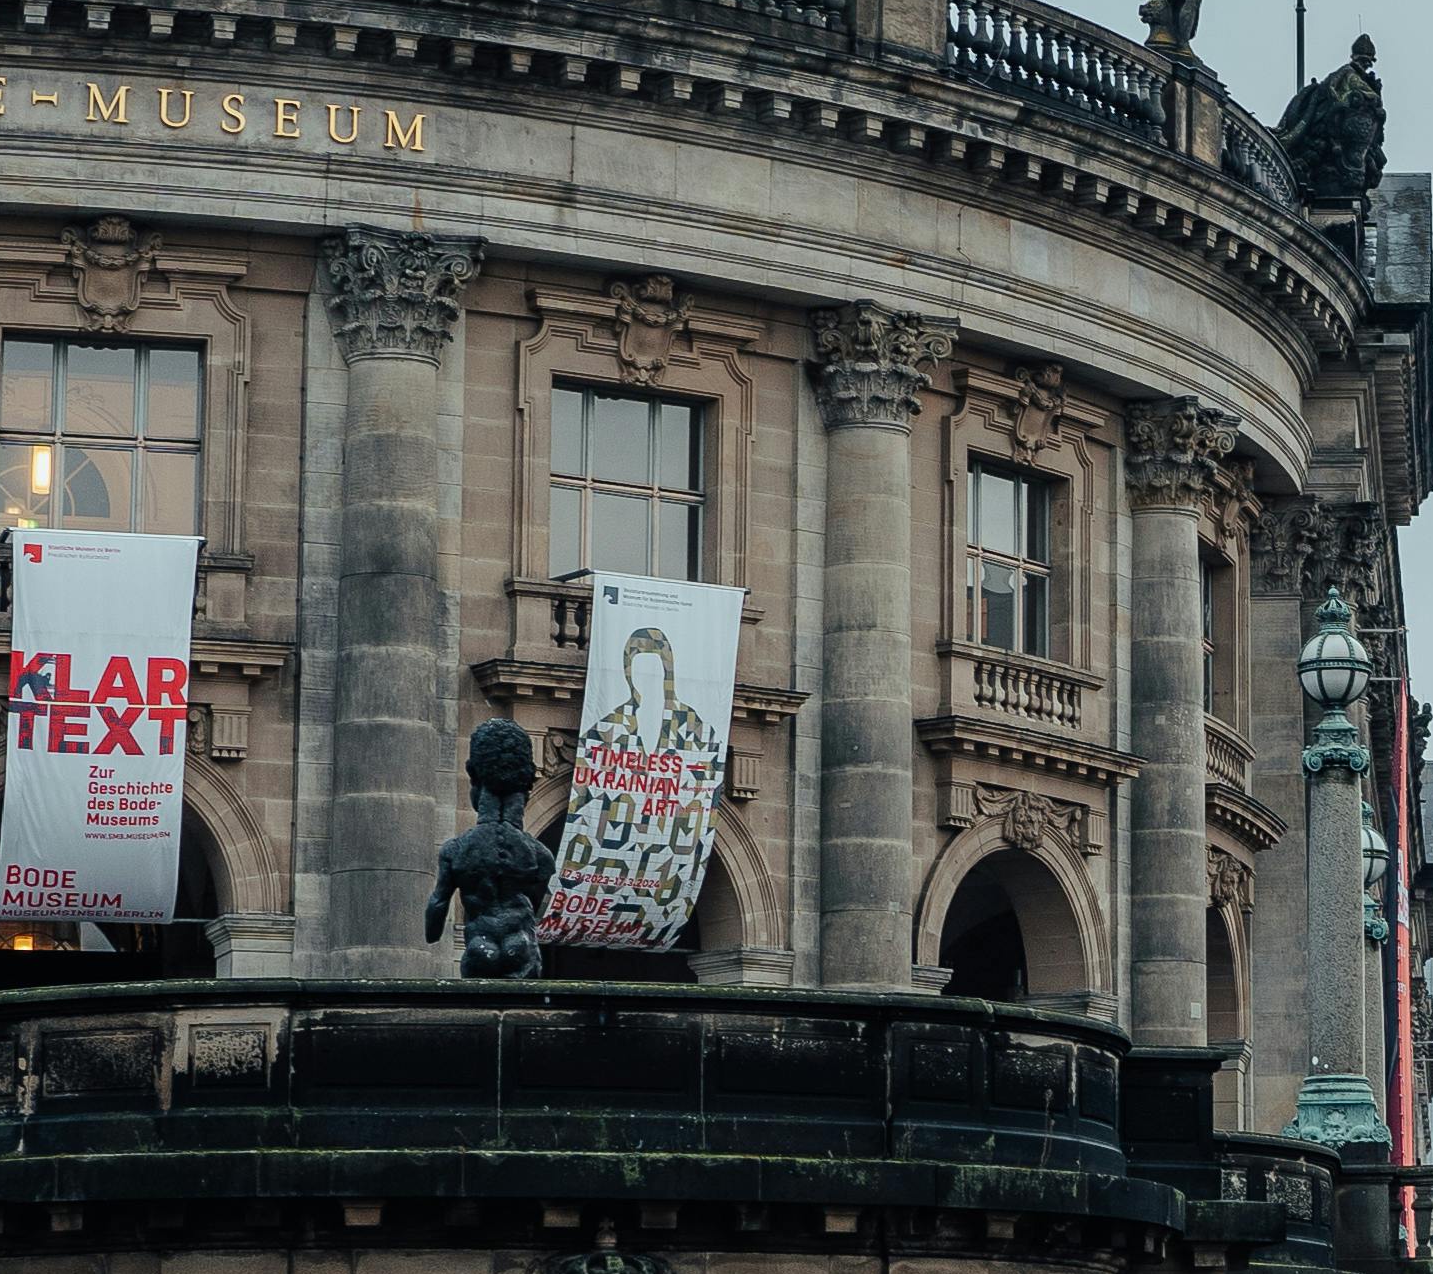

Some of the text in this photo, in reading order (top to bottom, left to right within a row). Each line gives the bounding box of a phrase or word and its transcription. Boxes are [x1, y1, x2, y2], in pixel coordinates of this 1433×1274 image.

[9, 651, 187, 705] KLAR
[8, 701, 187, 755] TEXT
[590, 746, 683, 774] TIMELESS
[89, 765, 115, 779] Zur
[575, 766, 680, 796] UKRAINIAN
[88, 781, 173, 795] Geschichte
[87, 797, 162, 811] des Bode-
[641, 798, 680, 817] ART
[87, 812, 159, 826] Museums
[5, 864, 77, 889] BODE
[2, 889, 122, 908] MUSEUM
[551, 891, 614, 916] BODE
[1, 908, 164, 918] MUSEUMSINSEL BERLIN
[537, 914, 644, 936] MUSEUM
